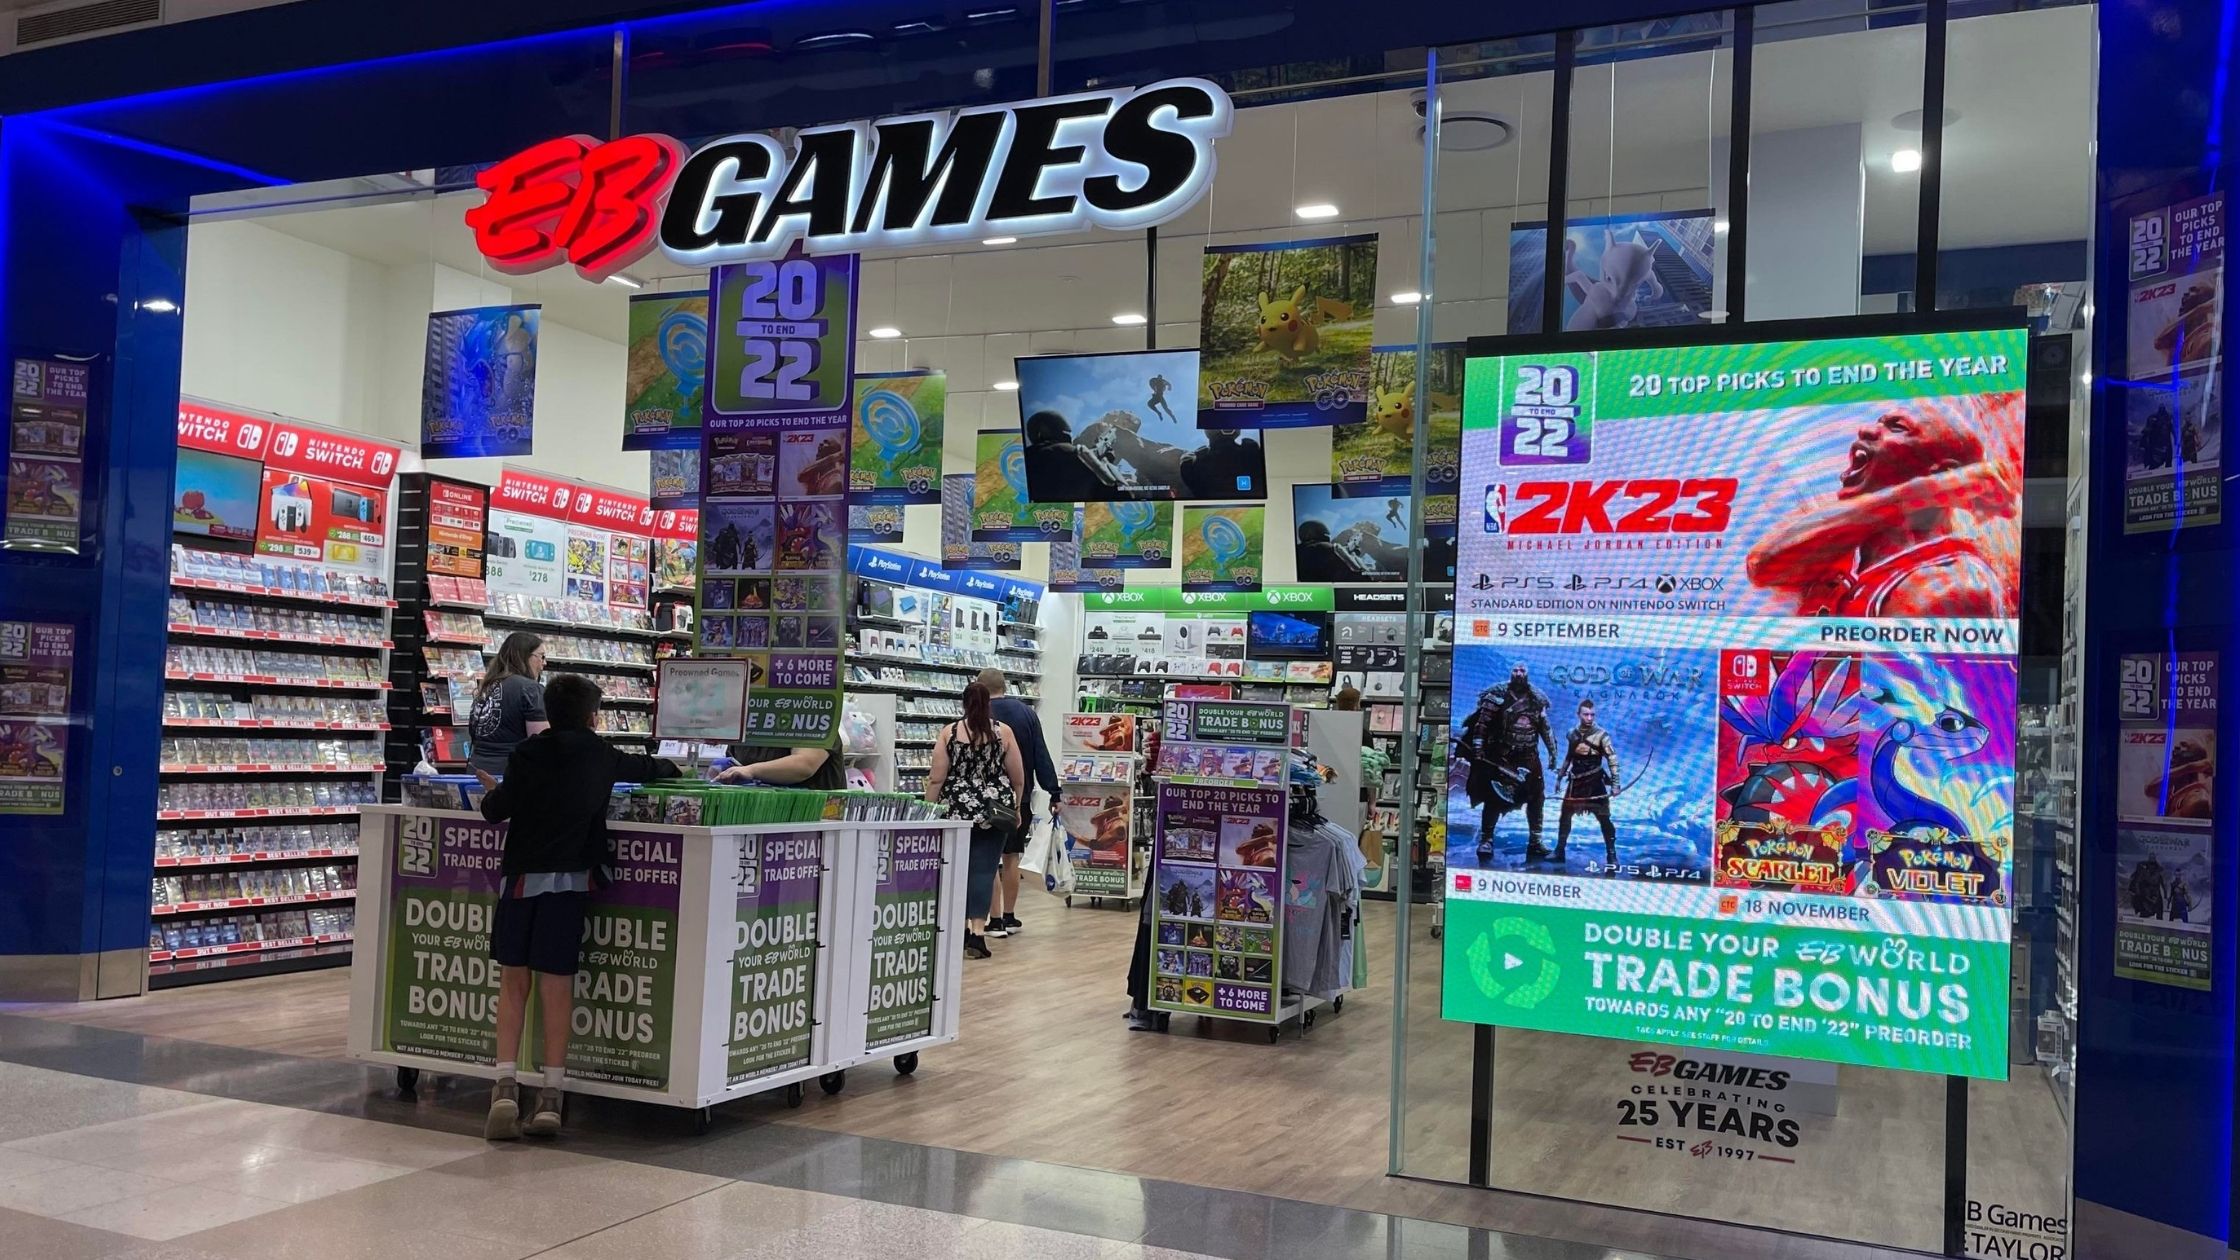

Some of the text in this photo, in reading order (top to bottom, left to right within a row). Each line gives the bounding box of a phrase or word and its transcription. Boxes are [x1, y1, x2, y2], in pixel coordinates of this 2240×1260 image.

[463, 80, 1225, 281] EB GAMES
[2175, 201, 2223, 222] OUR TOP
[2134, 217, 2162, 243] 20
[2182, 215, 2215, 232] PICKS
[2180, 226, 2220, 245] TO END
[2171, 237, 2224, 259] THE YEAR
[2133, 247, 2160, 272] 22
[743, 260, 820, 320] 20
[762, 325, 795, 335] TO END
[740, 340, 818, 400] 22
[1629, 355, 2008, 397] 20 TOP PICKS TO END THE YEAR
[1515, 365, 1578, 406] 20
[1316, 388, 1351, 410] GO
[710, 415, 847, 428] OUR TOP 20 PICKS TO END THE YEAR
[1514, 417, 1575, 457] 22
[305, 446, 363, 469] SWITCH
[308, 438, 365, 457] NINTENDO
[503, 486, 547, 504] SWITCH
[506, 479, 549, 492] NINTENDO
[596, 505, 635, 521] SWITCH
[599, 498, 637, 511] NINTENDO
[1507, 478, 1738, 534] 2K23
[1507, 539, 1723, 550] MICHAEL JORDAN EDITION
[877, 560, 902, 571] PlayStation
[928, 571, 951, 581] PlayStation
[975, 579, 995, 590] PlayStation
[1501, 576, 1724, 591] PS5 PS4 XBOX
[1116, 592, 1144, 602] XBOX
[1199, 592, 1226, 602] XBOX
[1283, 592, 1313, 602] XBOX
[1353, 593, 1404, 601] HEADSETS
[1470, 598, 1726, 611] STANDARD EDITION ON NINTENDO SWITCH
[1498, 623, 2004, 643] 9 SEPTEMBER PREORDER NOW
[787, 660, 833, 671] 6 MORE
[2123, 660, 2152, 683] 20
[777, 673, 830, 685] TO COME
[1727, 682, 1762, 690] SWITCH
[1167, 702, 1189, 719] 20
[2123, 690, 2150, 713] 22
[1166, 723, 1187, 740] 22
[1199, 716, 1238, 727] TRADE
[1194, 778, 1234, 786] PREORDER
[1166, 788, 1279, 804] OUR TOP 20 PICKS TO
[1182, 800, 1260, 814] END THE YEAR
[402, 845, 430, 874] 22
[635, 868, 678, 885] OFFER
[1604, 864, 1701, 879] PS5 PS4
[1726, 857, 1836, 884] SCARLET
[1478, 881, 1581, 898] 9 NOVEMBER
[1886, 867, 1985, 896] VIOLET
[214, 900, 229, 908] NOW
[1745, 900, 1870, 921] 18 NOVEMBER
[873, 900, 936, 931] DOUBLE
[736, 912, 816, 950] DOUBLE
[197, 947, 208, 955] OUT
[739, 944, 810, 968] YOUR EB WORLD
[1585, 923, 1970, 974] DOUBLE YOUR EB WORLD
[413, 951, 501, 988] TRADE
[874, 947, 928, 978] TRADE
[740, 965, 806, 1004] TRADE
[870, 977, 927, 1011] BONUS
[1227, 988, 1268, 1001] 6 MORE
[1584, 951, 1969, 1023] TRADE BONUS
[1220, 998, 1265, 1011] TO COME
[734, 999, 806, 1041] BONUS
[1585, 997, 1668, 1018] TOWARDS
[1673, 1005, 1711, 1023] ANY
[1751, 1014, 1773, 1029] TO
[1778, 1016, 1816, 1032] END
[1865, 1023, 1971, 1050] PREORDER
[1628, 1051, 1791, 1091] EB GAMES
[1631, 1085, 1786, 1113] CELEBRATING
[1616, 1099, 1800, 1148] 25 YEARS
[1656, 1137, 1686, 1151] EST
[1717, 1146, 1755, 1161] 1997
[1967, 1200, 1982, 1222] B
[1988, 1204, 2068, 1235] Games
[1970, 1232, 2065, 1260] TAYLOR
